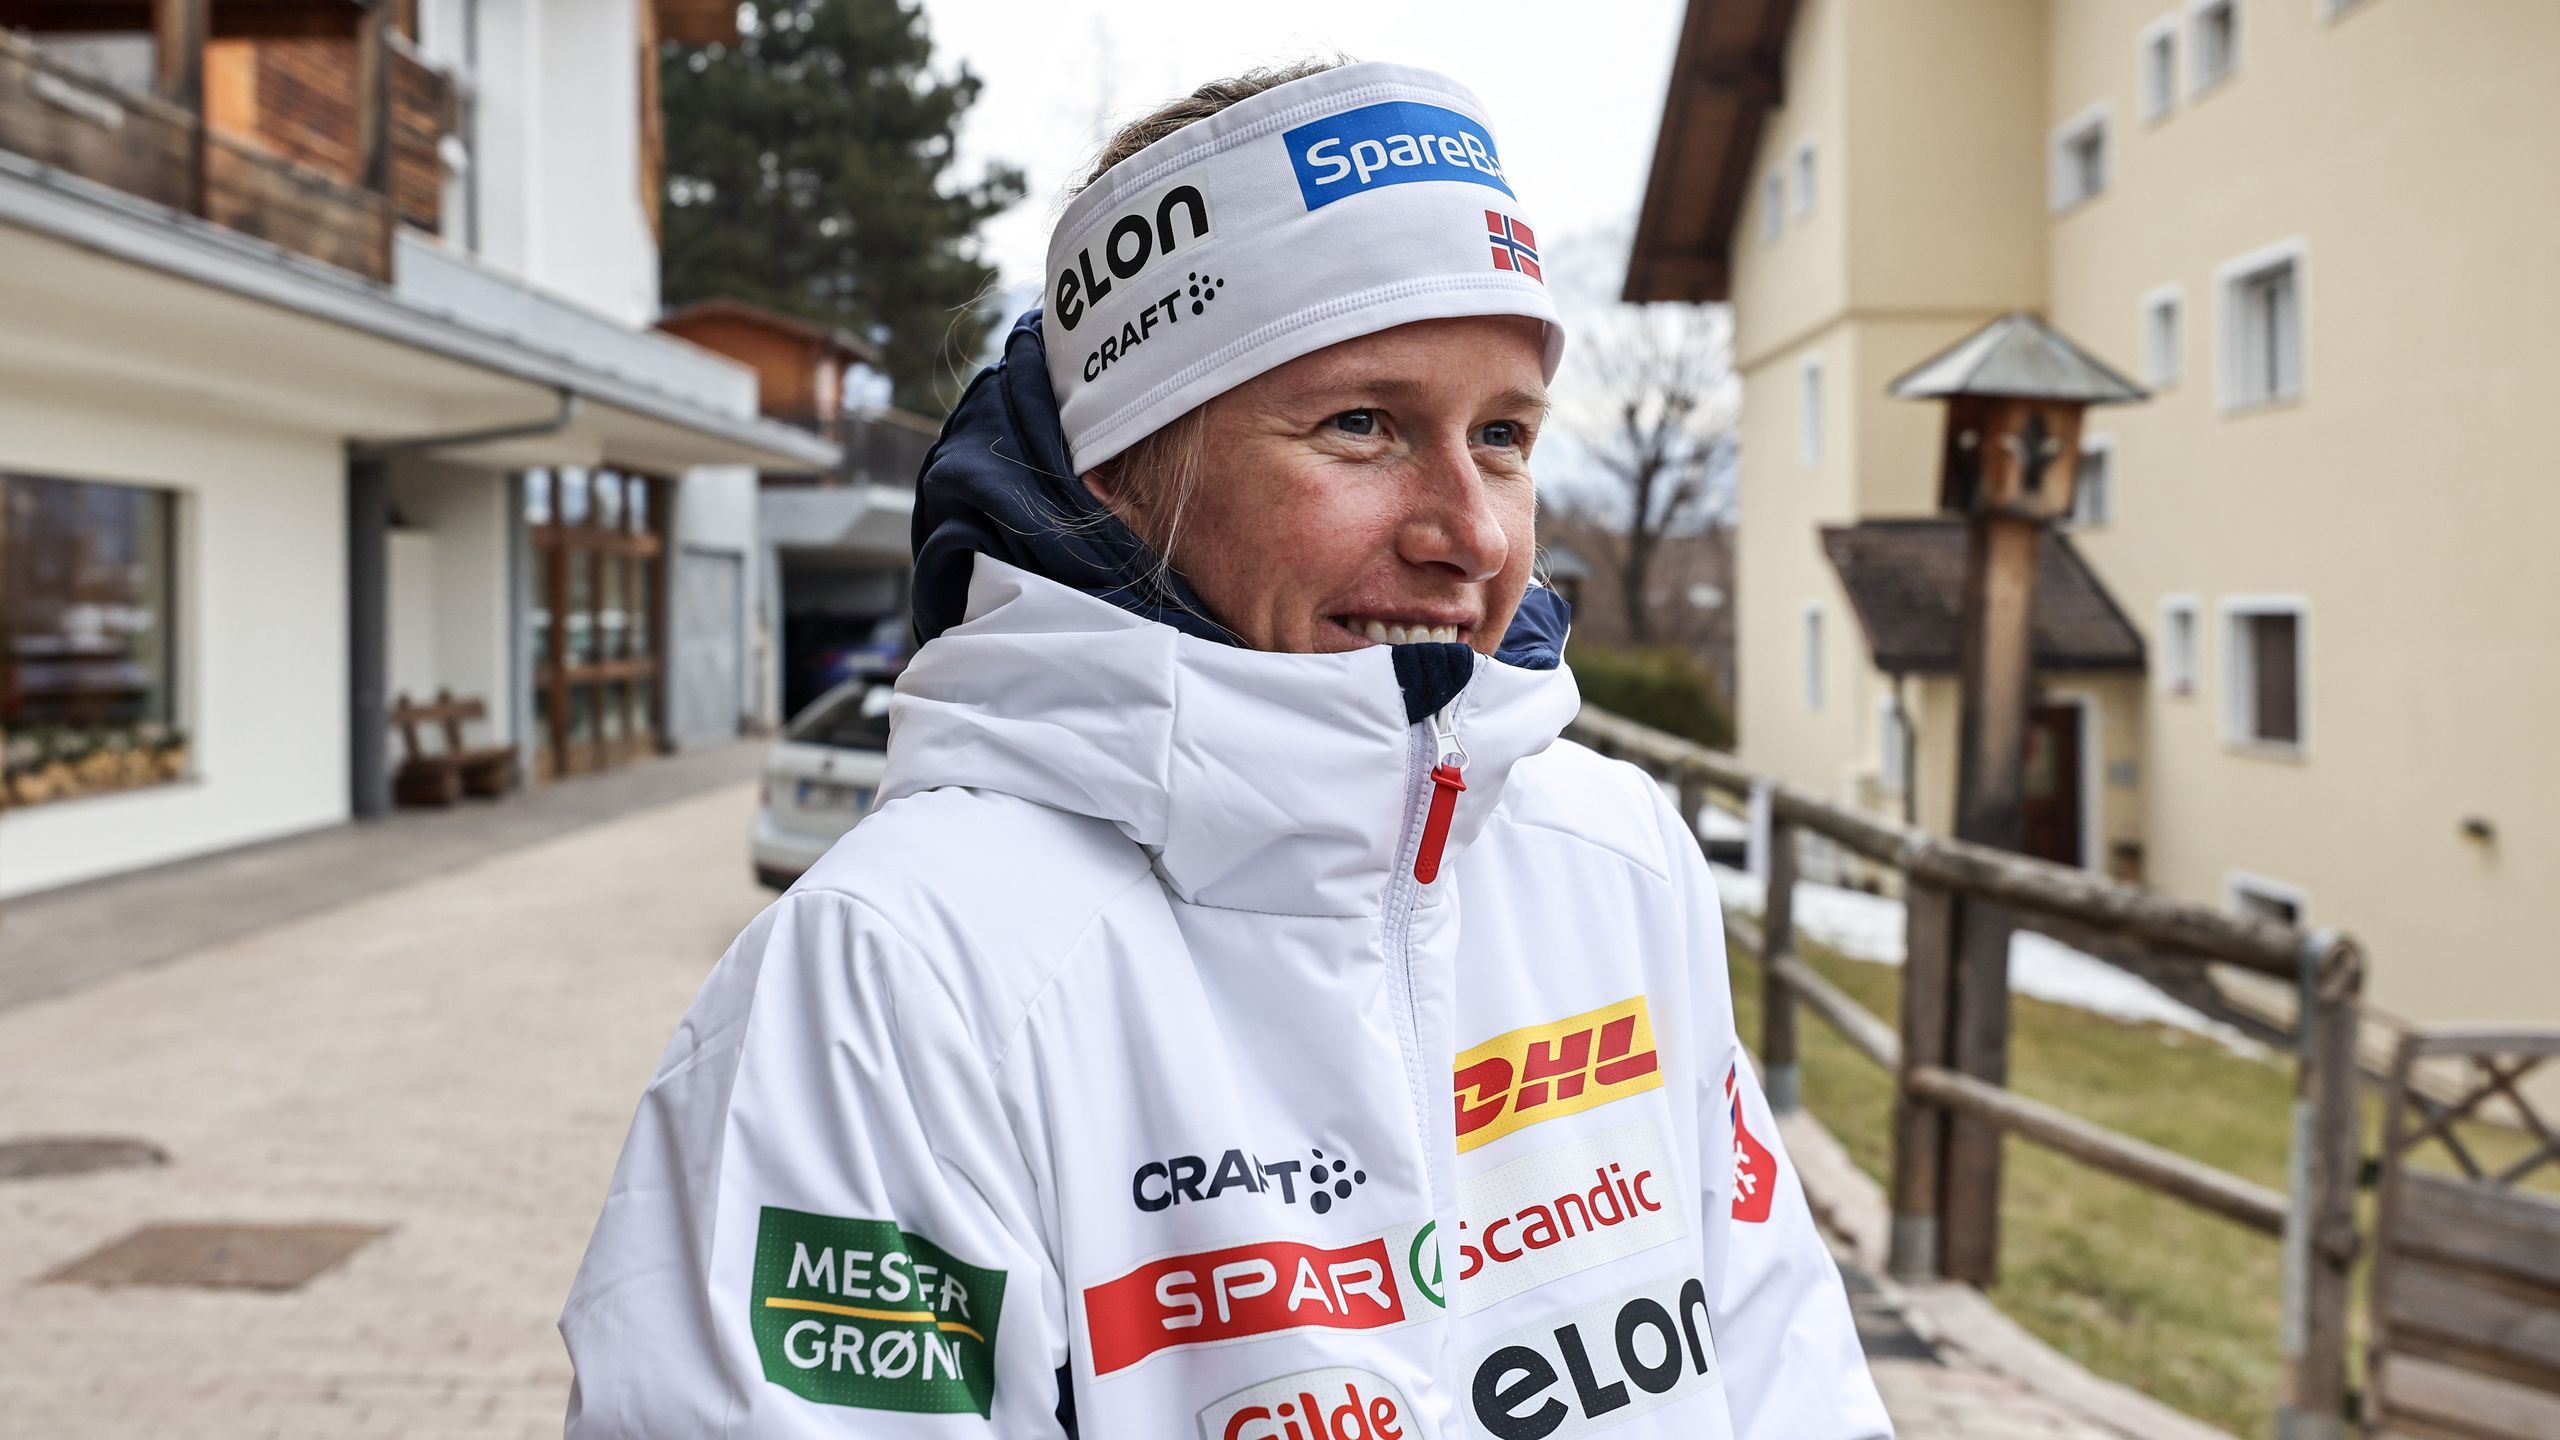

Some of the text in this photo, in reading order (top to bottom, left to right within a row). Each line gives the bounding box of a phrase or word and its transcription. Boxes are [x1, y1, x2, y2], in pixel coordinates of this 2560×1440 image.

[1083, 289, 1180, 383] CRAFT
[1454, 1014, 1657, 1136] DHL
[1133, 1149, 1301, 1212] CRAT
[787, 1242, 971, 1320] MESER
[1156, 1257, 1391, 1330] SPAR
